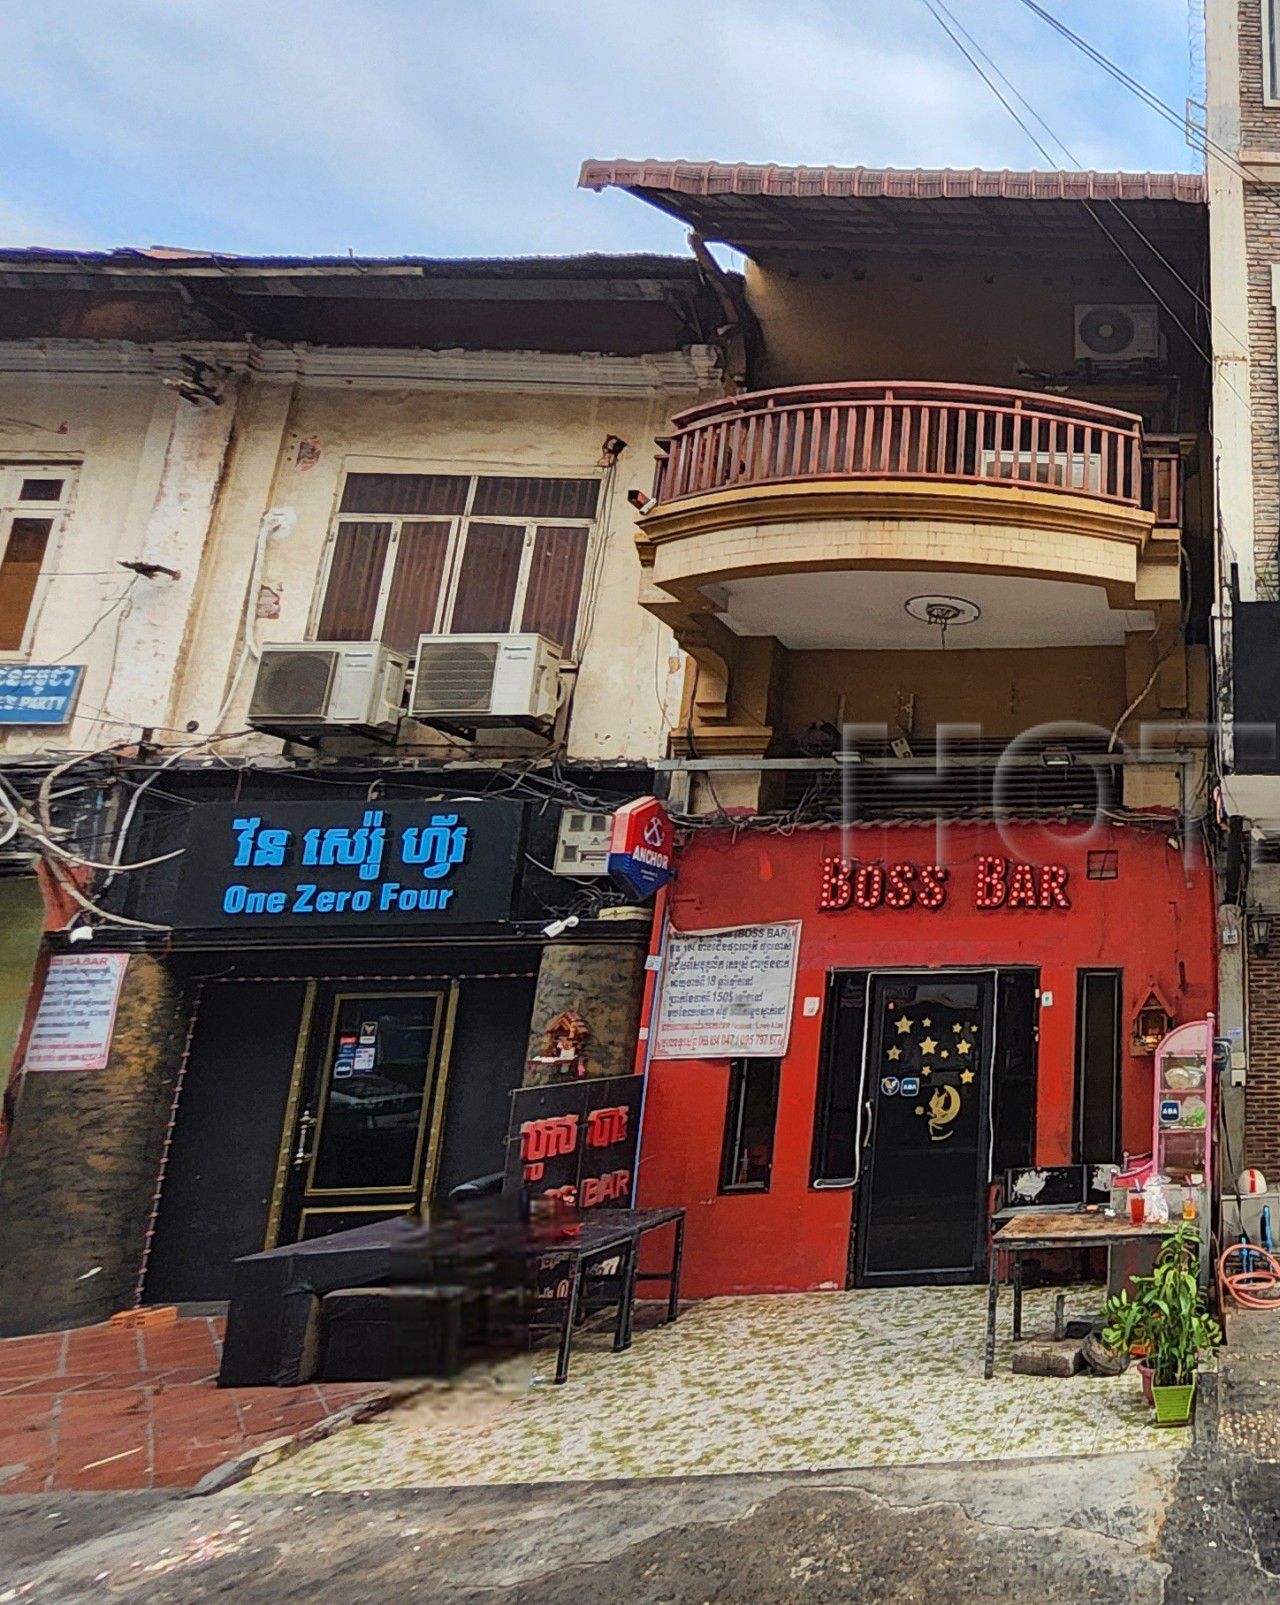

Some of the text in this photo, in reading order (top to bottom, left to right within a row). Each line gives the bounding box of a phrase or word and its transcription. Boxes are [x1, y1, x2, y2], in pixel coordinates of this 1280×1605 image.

[632, 845, 669, 869] ANCHOR
[223, 883, 454, 914] One Zero Four
[1162, 1107, 1179, 1116] ABA
[580, 1170, 630, 1207] BAR
